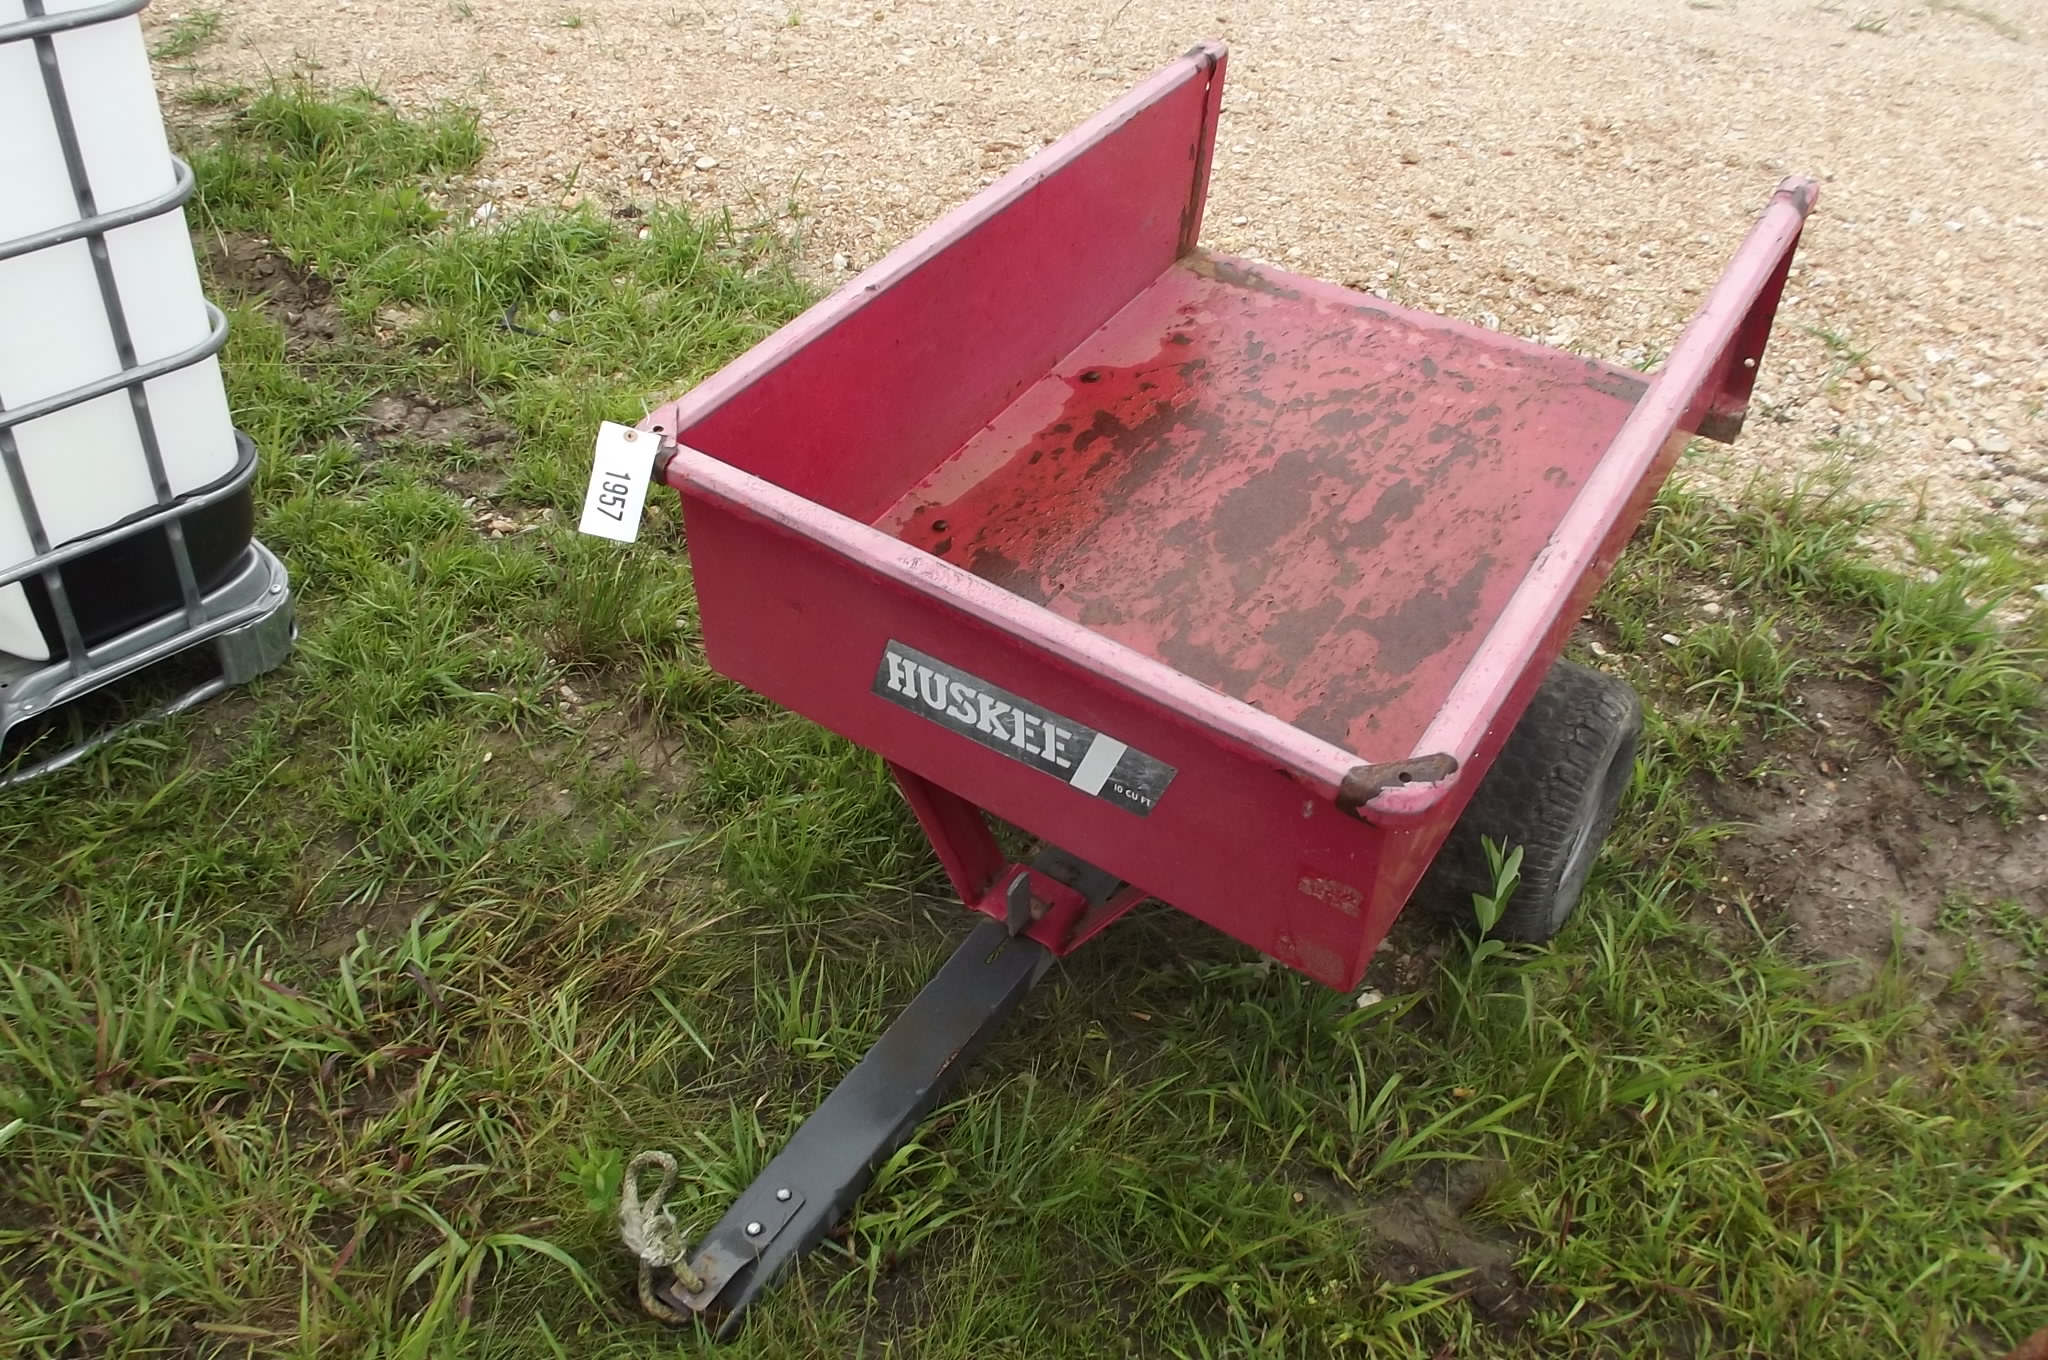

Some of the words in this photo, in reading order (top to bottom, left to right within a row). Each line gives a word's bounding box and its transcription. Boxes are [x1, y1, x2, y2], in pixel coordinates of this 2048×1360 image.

[597, 471, 631, 522] 1957
[886, 651, 1073, 769] HUSKEE
[1113, 783, 1124, 794] 10
[1125, 789, 1139, 801] CU
[1140, 795, 1152, 807] FT
